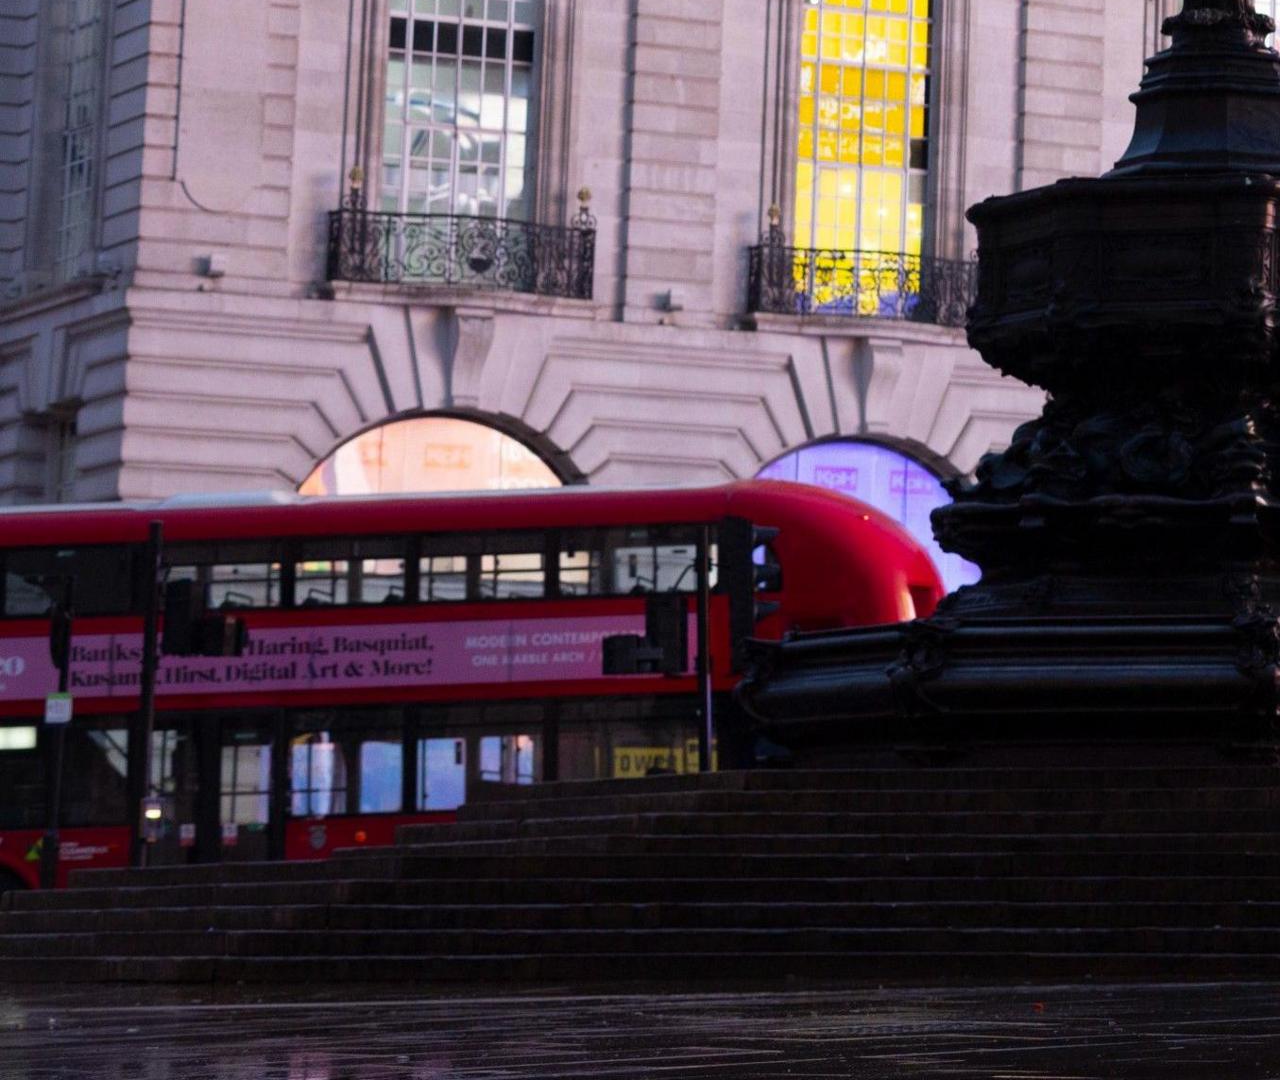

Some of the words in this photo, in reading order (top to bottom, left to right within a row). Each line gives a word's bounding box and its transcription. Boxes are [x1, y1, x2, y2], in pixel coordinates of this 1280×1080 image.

[333, 632, 435, 656] Basquiat,
[532, 630, 646, 647] CONTEMP
[71, 644, 145, 663] Banks
[472, 654, 498, 666] ONE
[71, 669, 161, 688] Kusam,
[165, 665, 221, 686] Hirst,
[225, 662, 297, 682] Digital
[304, 660, 339, 678] Art
[344, 663, 364, 678] &
[369, 658, 433, 677] More!
